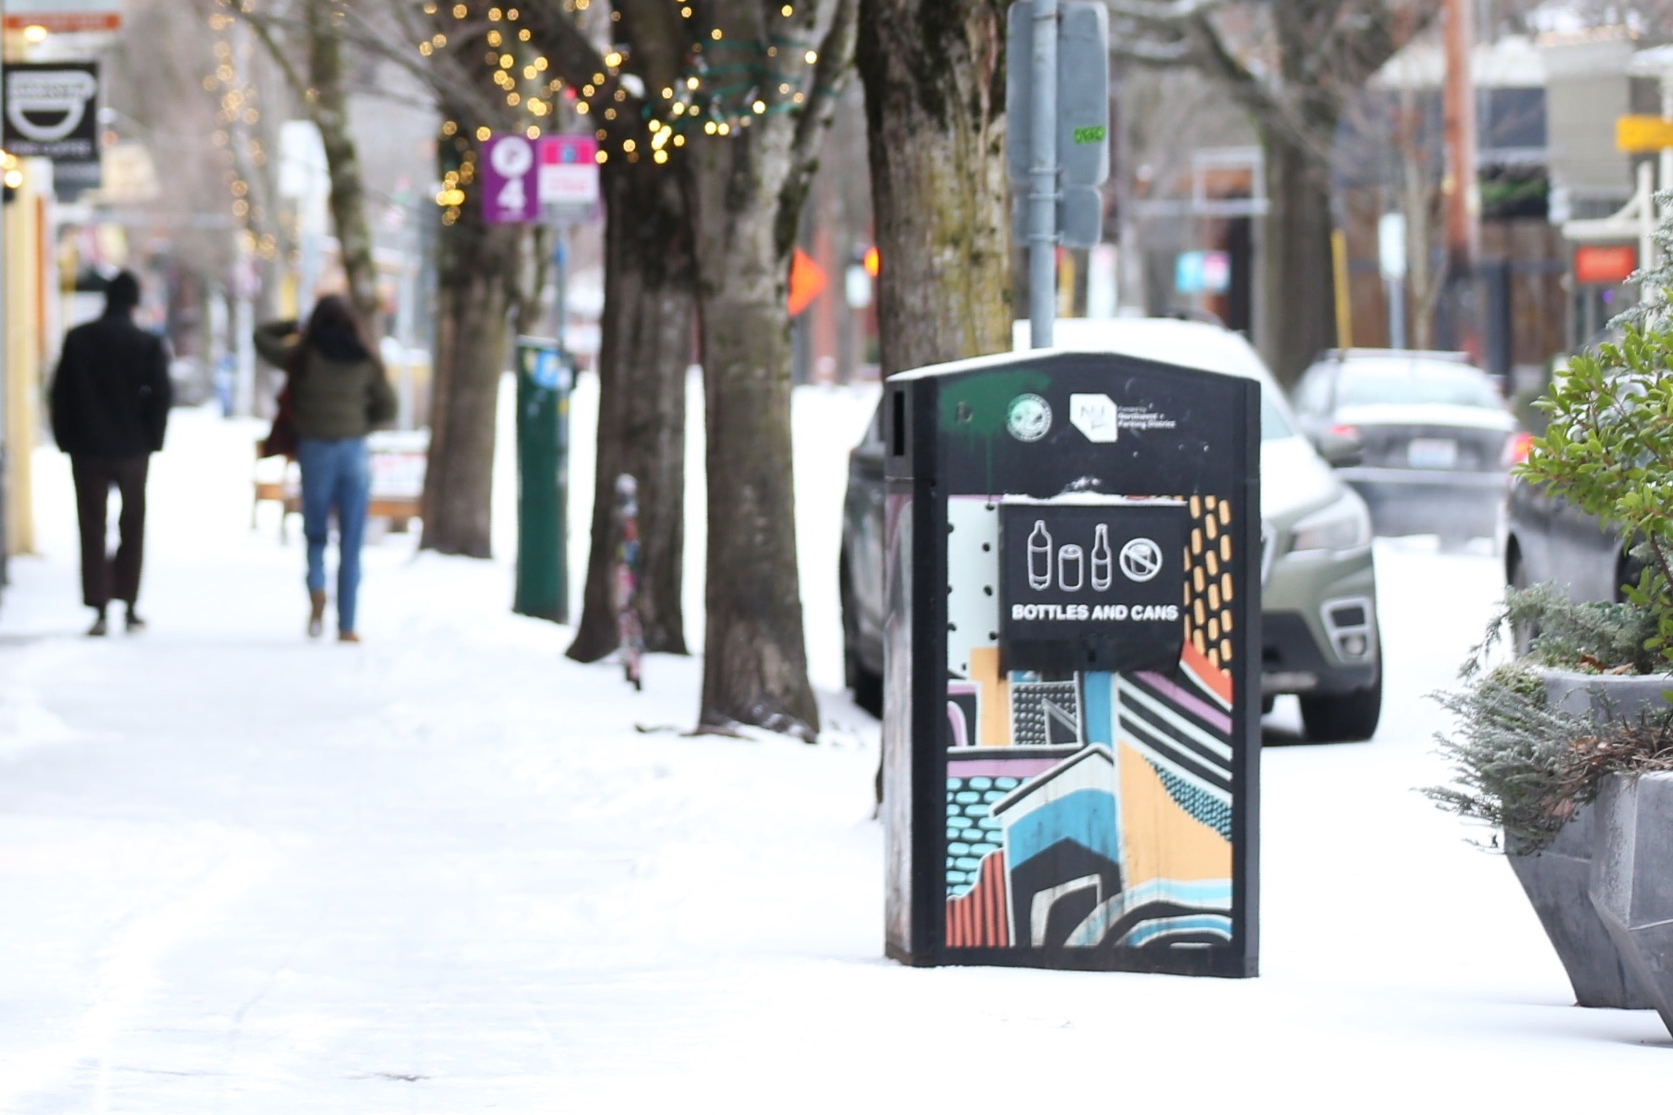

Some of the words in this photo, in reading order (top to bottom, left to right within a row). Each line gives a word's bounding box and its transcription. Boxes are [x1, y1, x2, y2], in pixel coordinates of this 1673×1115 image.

[1011, 604, 1090, 621] BOTTLES
[1091, 604, 1128, 621] AND
[1130, 604, 1179, 622] CANS
